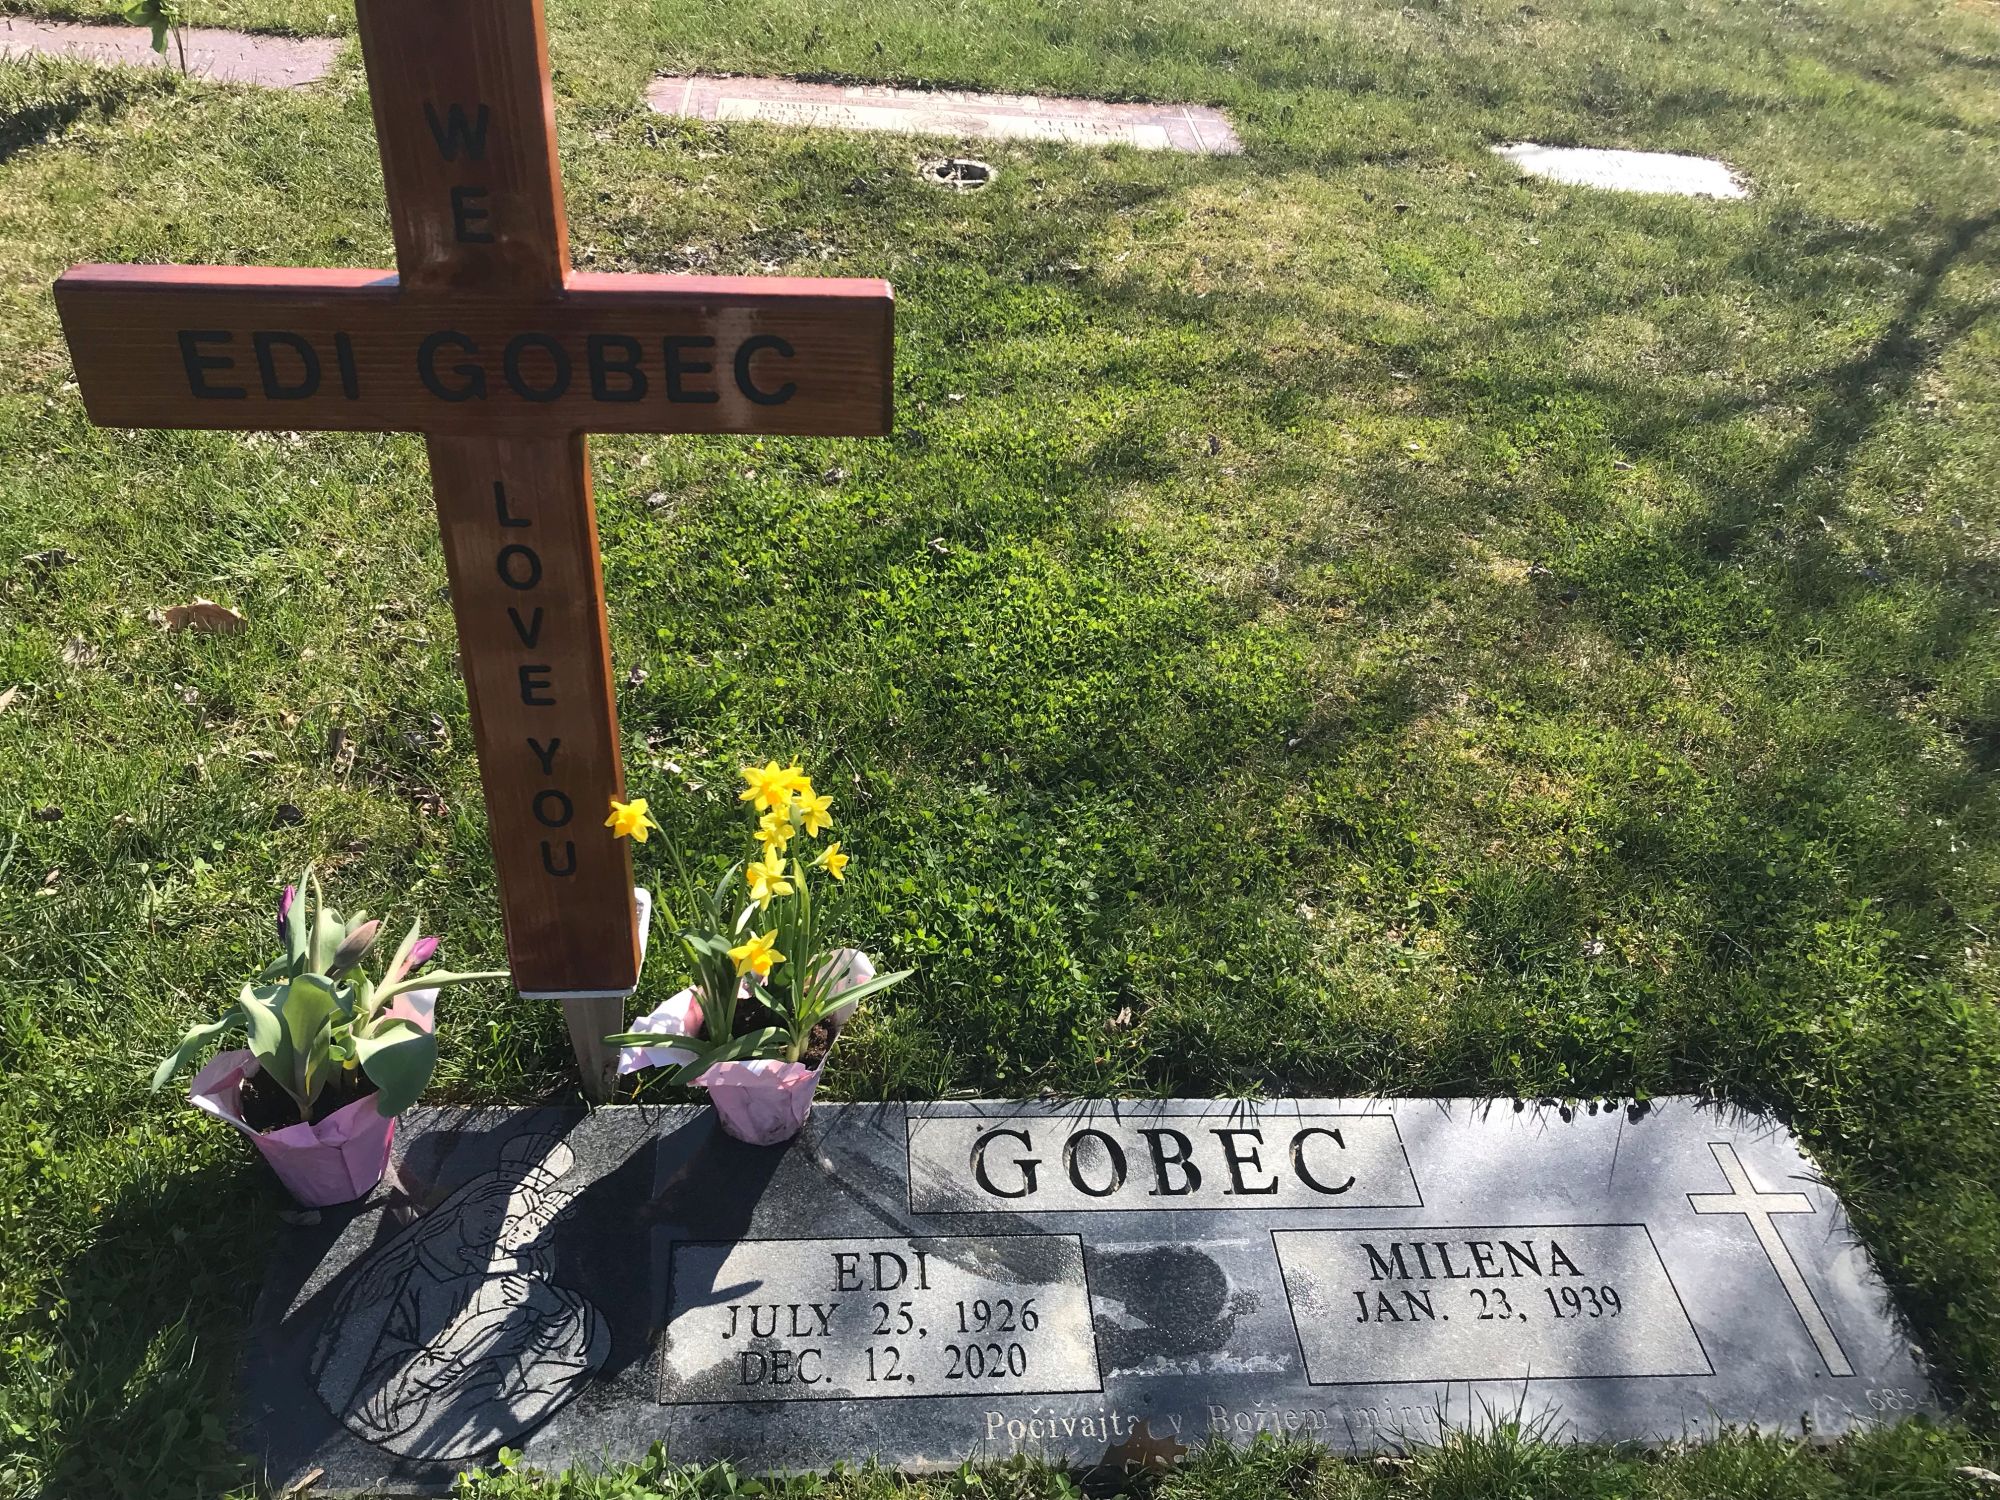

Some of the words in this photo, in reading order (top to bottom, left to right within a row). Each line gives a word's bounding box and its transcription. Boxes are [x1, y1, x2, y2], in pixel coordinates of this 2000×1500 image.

[423, 102, 494, 242] WE
[177, 330, 360, 400] EDI
[416, 330, 797, 405] GOBEC
[493, 480, 557, 706] LOVE
[526, 737, 578, 877] YOU
[970, 1127, 1356, 1199] GOBEC
[831, 1251, 931, 1292] EDI
[1360, 1239, 1585, 1281] MILENA
[722, 1303, 840, 1339] JULY
[871, 1301, 928, 1339] 25,
[956, 1298, 1040, 1334] 1926
[1352, 1290, 1450, 1323] JAN.
[1469, 1288, 1527, 1324] 23,
[1543, 1285, 1623, 1319] 1939
[737, 1348, 832, 1387] DEC.
[865, 1346, 916, 1385] 12,
[944, 1342, 1028, 1380] 2020
[1353, 1397, 1438, 1427] miru
